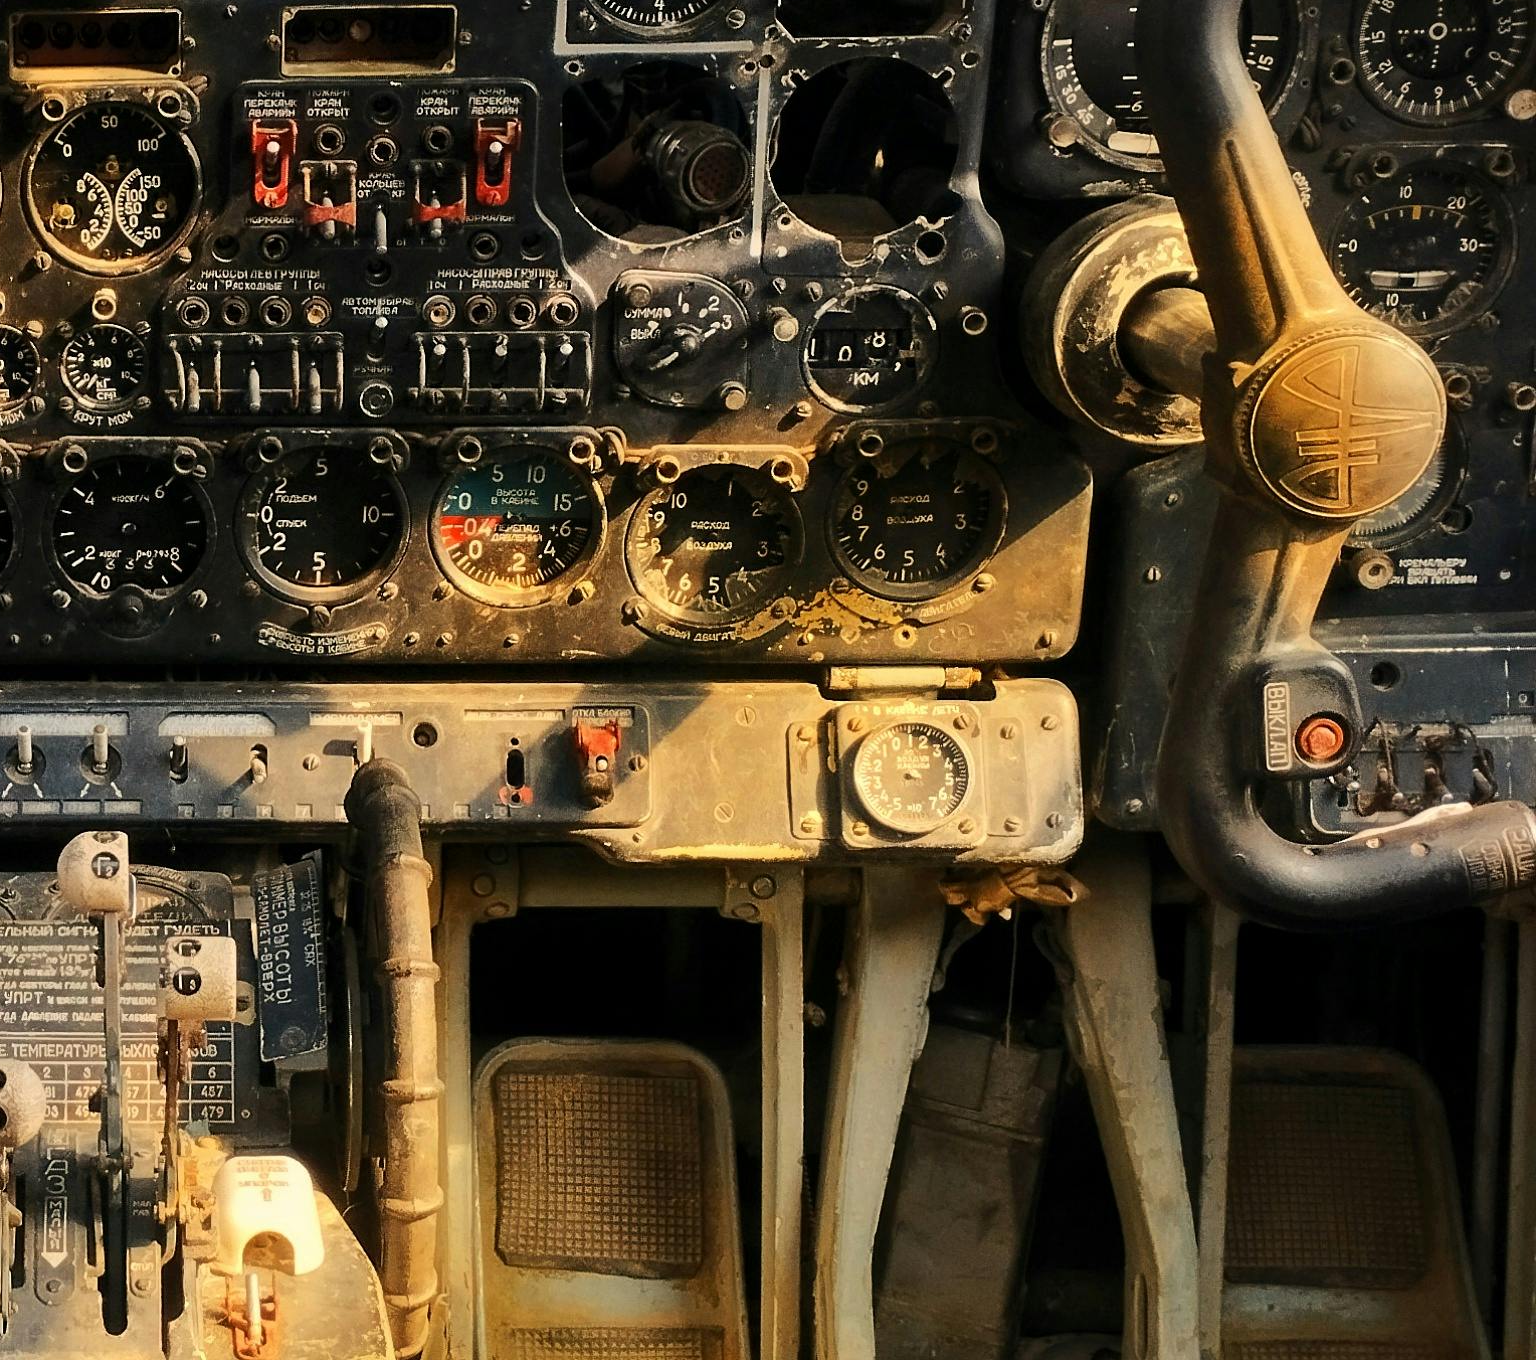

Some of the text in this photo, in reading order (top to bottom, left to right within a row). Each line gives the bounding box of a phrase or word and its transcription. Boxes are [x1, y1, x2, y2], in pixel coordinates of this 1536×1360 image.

[244, 98, 297, 108] ПЕРЕКАЧК
[314, 98, 342, 107] КРАН
[420, 97, 448, 106] КРАН
[307, 108, 351, 117] ОТКРЫТ
[416, 106, 460, 116] ОТКРЫТ
[101, 116, 118, 128] 50
[138, 139, 159, 151] 100
[139, 175, 161, 188] 150
[1446, 196, 1466, 209] 20
[136, 226, 161, 239] -50
[1459, 238, 1478, 252] 30
[201, 268, 248, 279] НАСОСЫ
[273, 268, 320, 279] ГРУППЫ
[437, 268, 559, 279] НАСОСЫ ПРАВ ГРУППЫ
[352, 306, 398, 315] ТОПЛИВА
[721, 315, 732, 329] 3
[853, 372, 880, 385] КМ
[0, 410, 25, 426] МОМ
[73, 410, 133, 426] КРУТ МОМ
[491, 464, 504, 483] 5
[155, 485, 165, 499] 6
[496, 489, 536, 497] ВЫСОТА
[275, 494, 317, 503] ПОДЪЕМ
[491, 497, 540, 505] В КАБИНЕ
[554, 493, 572, 511] 15
[362, 505, 380, 523] 10
[275, 519, 308, 528] СПУСК
[312, 551, 326, 571] 5
[100, 575, 111, 590] 0
[918, 735, 928, 749] 2
[164, 924, 220, 936] ГУДЕТЬ
[208, 1066, 217, 1078] 6
